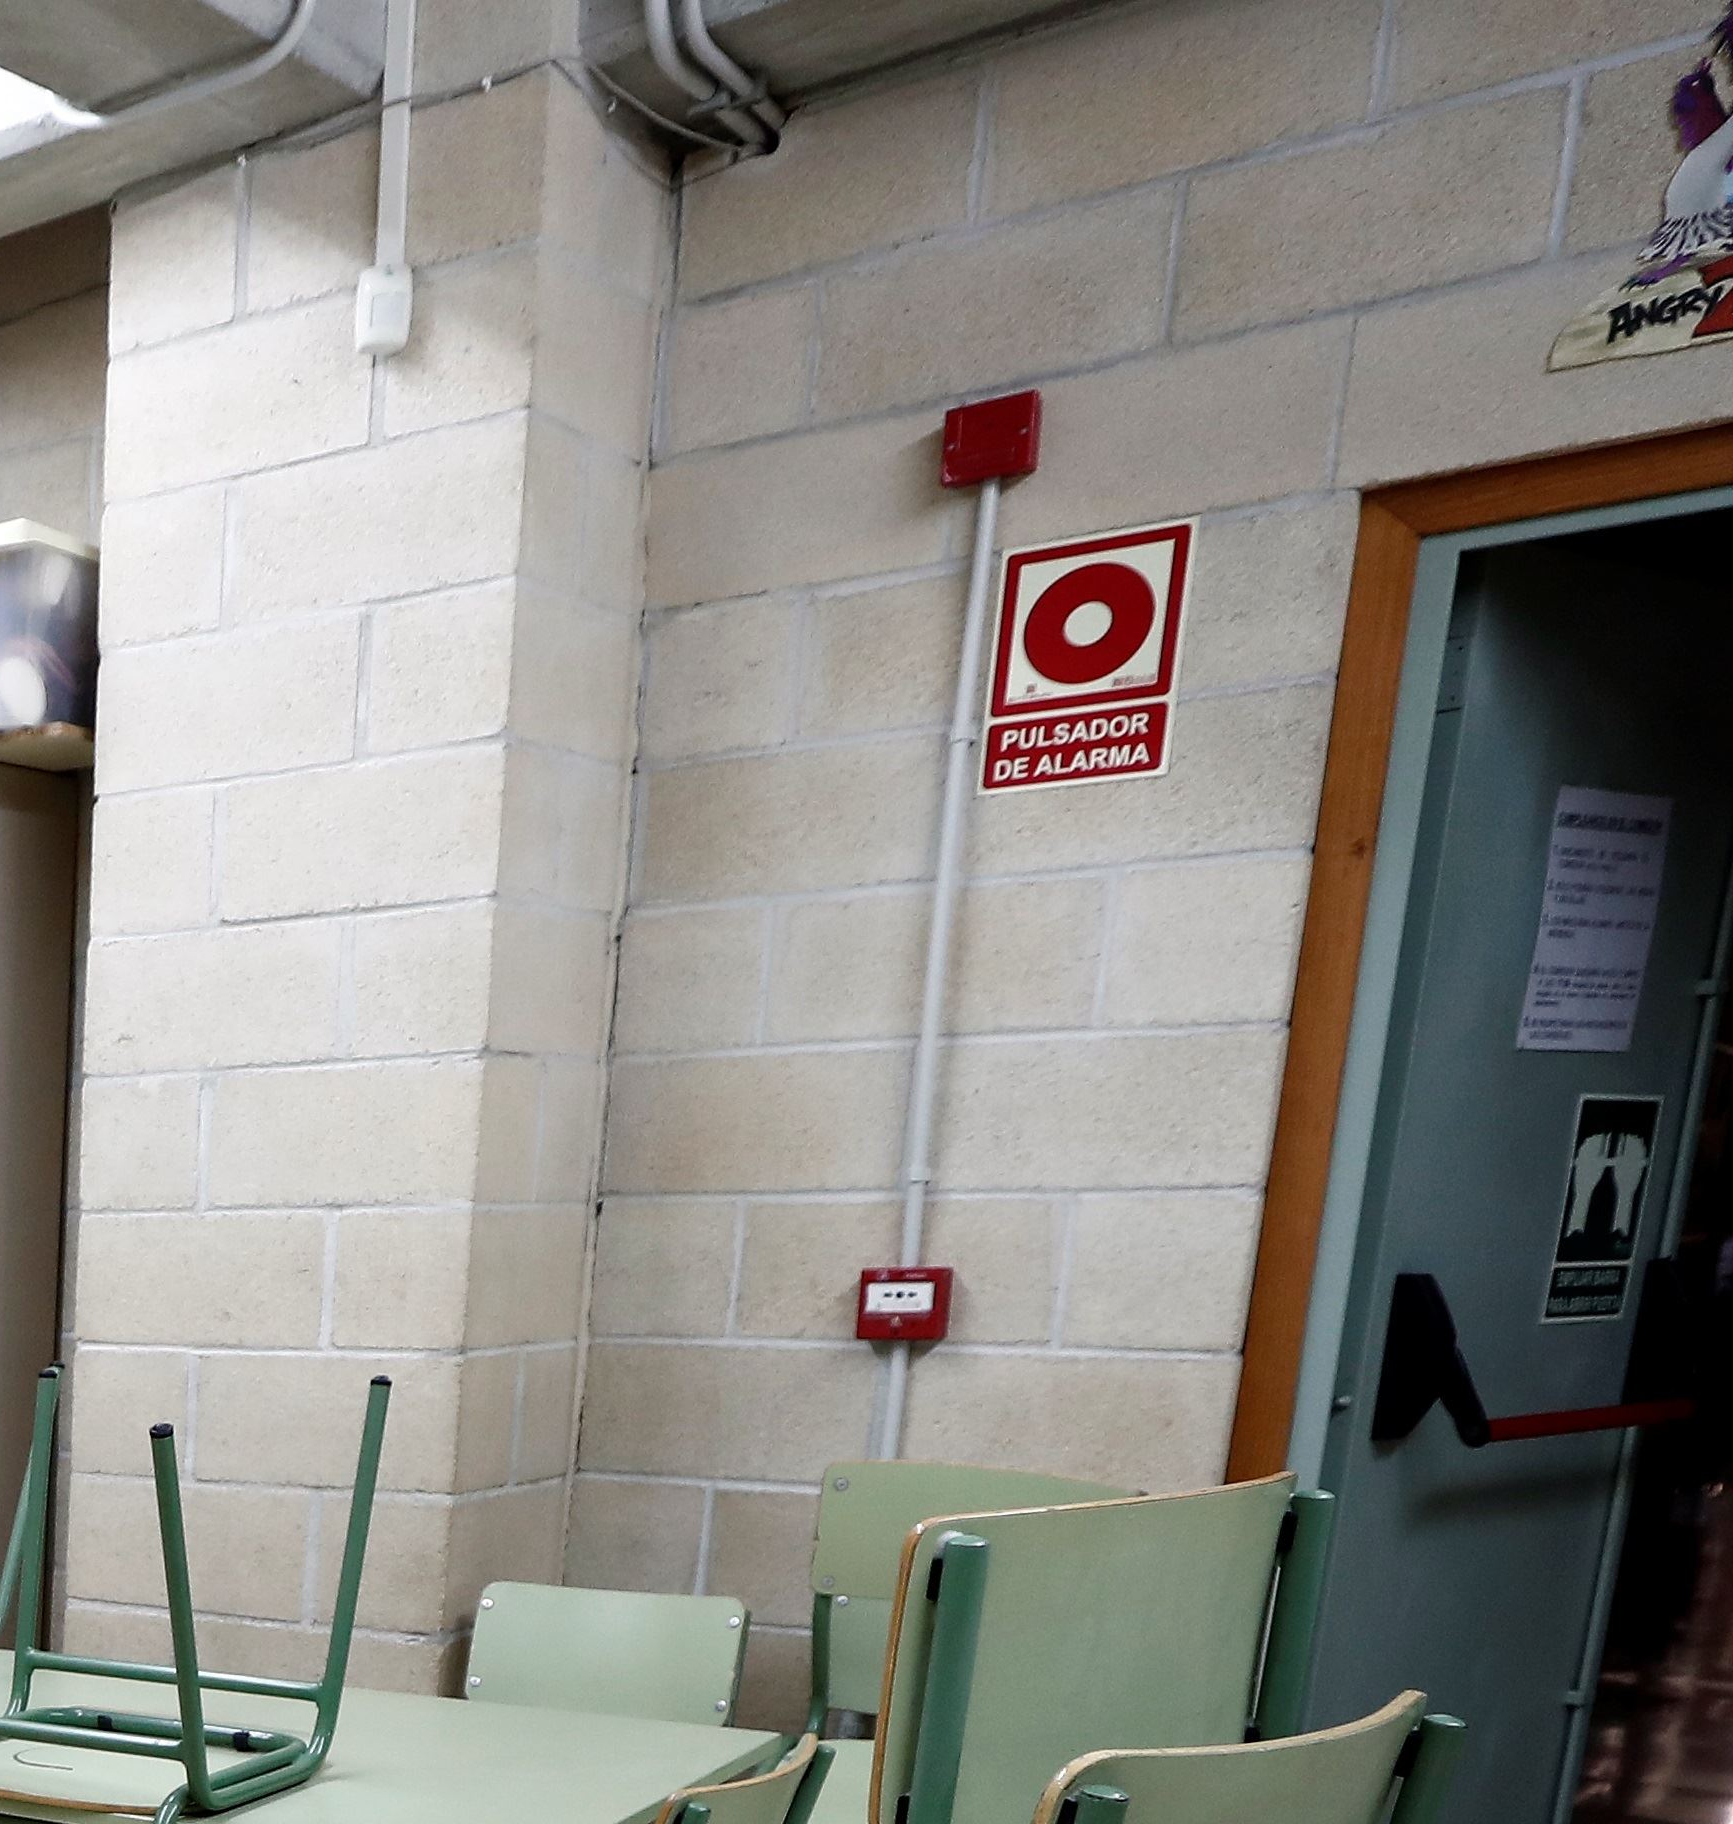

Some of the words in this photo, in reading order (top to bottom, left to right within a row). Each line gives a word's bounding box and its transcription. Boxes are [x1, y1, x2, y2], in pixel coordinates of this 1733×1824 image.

[1606, 284, 1726, 345] ANGRY
[1000, 712, 1150, 752] PULSADOR
[992, 756, 1030, 783] DE
[1034, 742, 1150, 777] ALARMA
